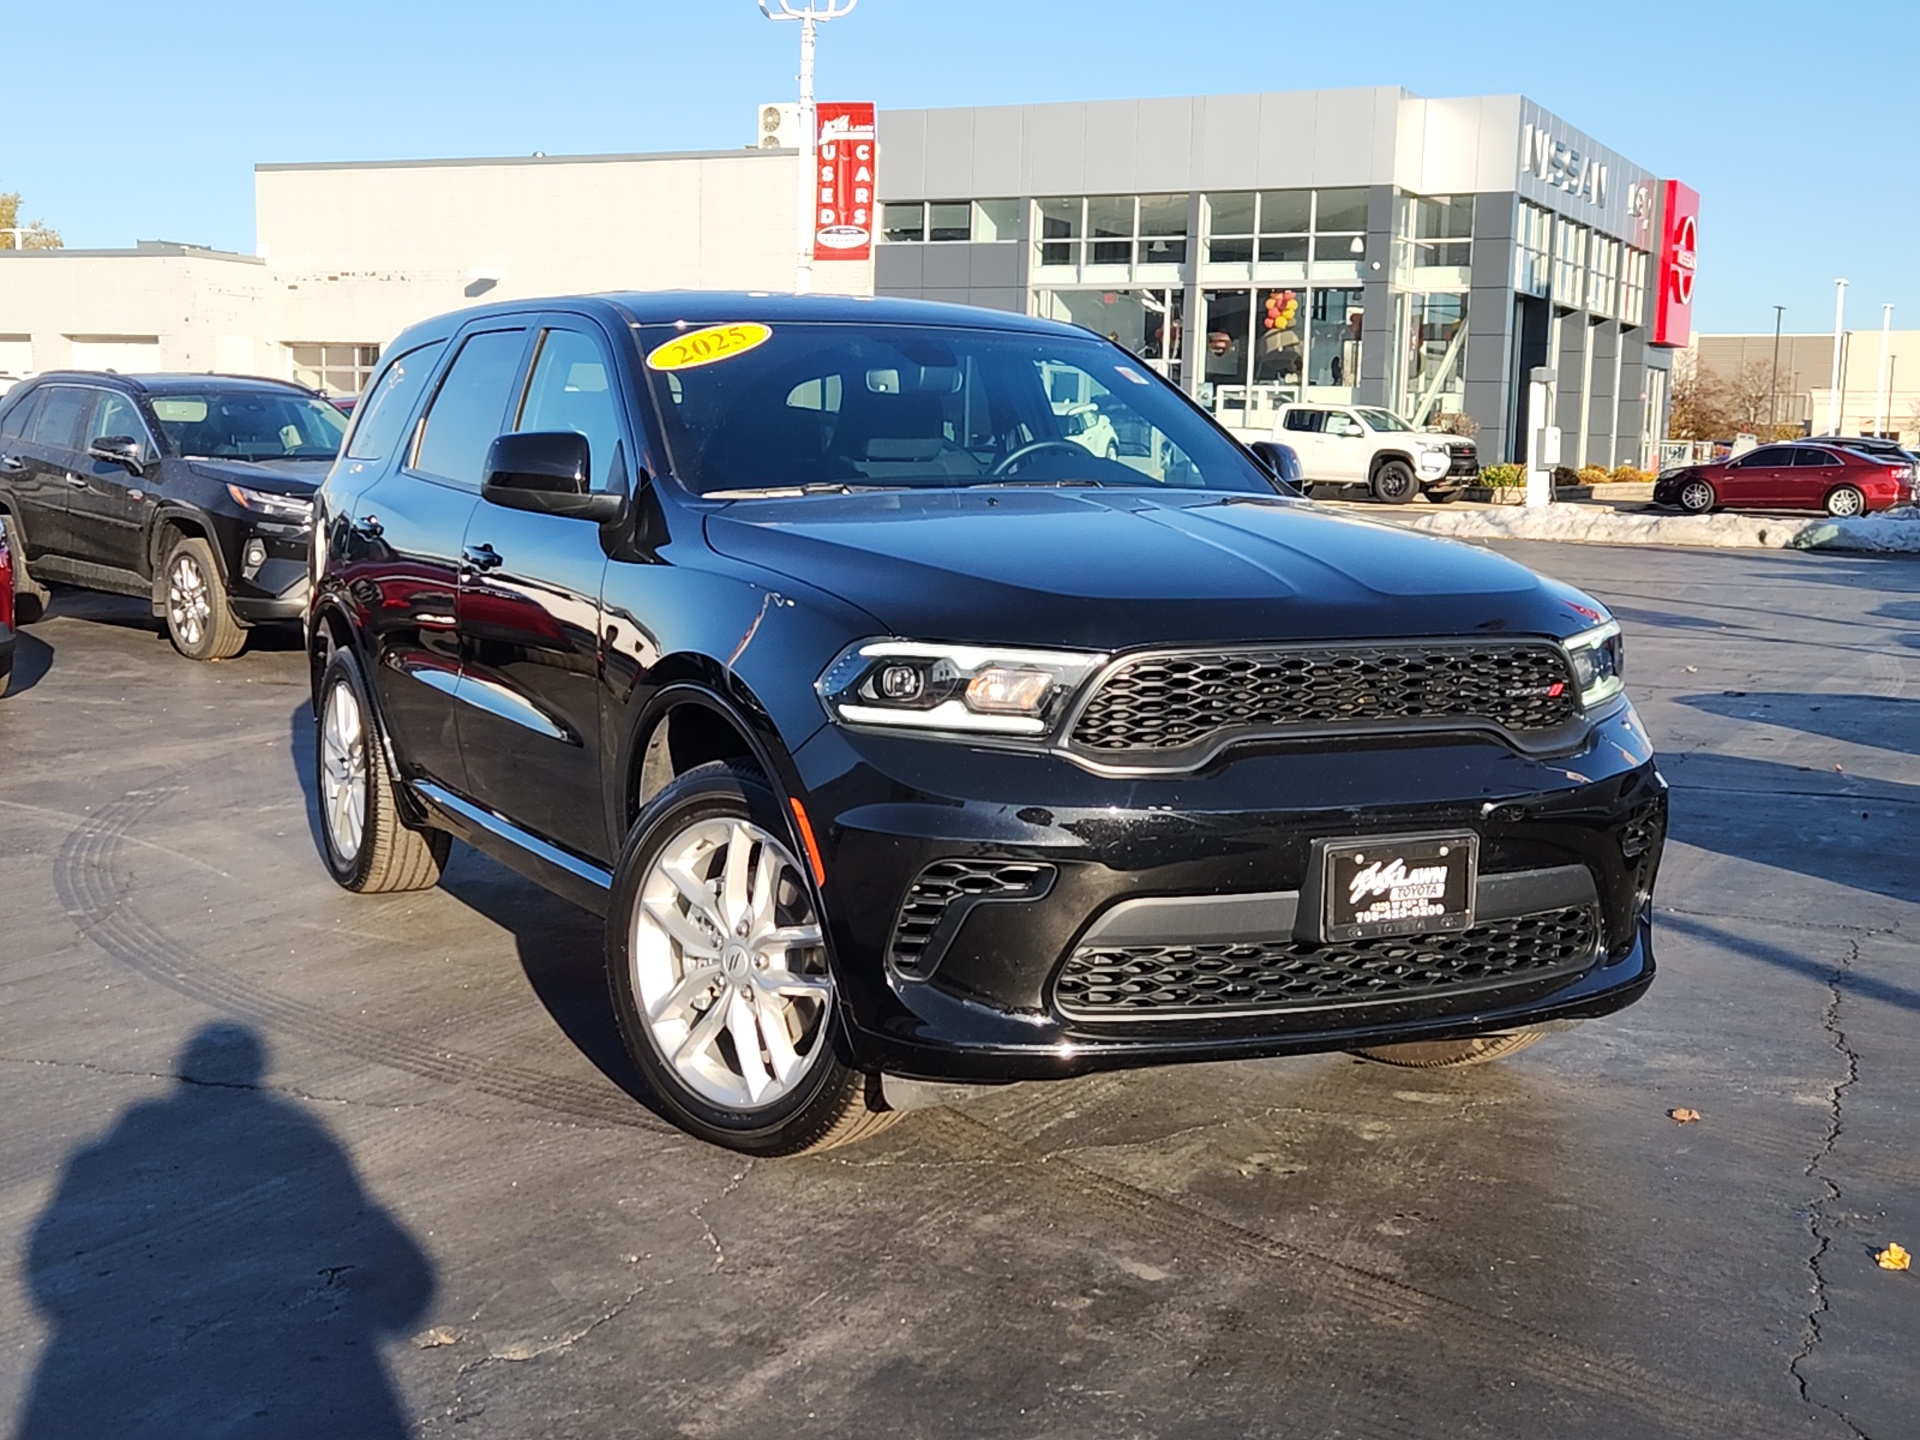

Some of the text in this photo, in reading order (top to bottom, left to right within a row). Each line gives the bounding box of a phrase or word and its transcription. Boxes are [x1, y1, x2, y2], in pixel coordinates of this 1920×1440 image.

[820, 145, 836, 224] USED
[854, 144, 871, 225] CARS
[1521, 123, 1608, 209] NISSAN
[671, 326, 747, 364] 2025
[1397, 885, 1438, 898] TOYOTA
